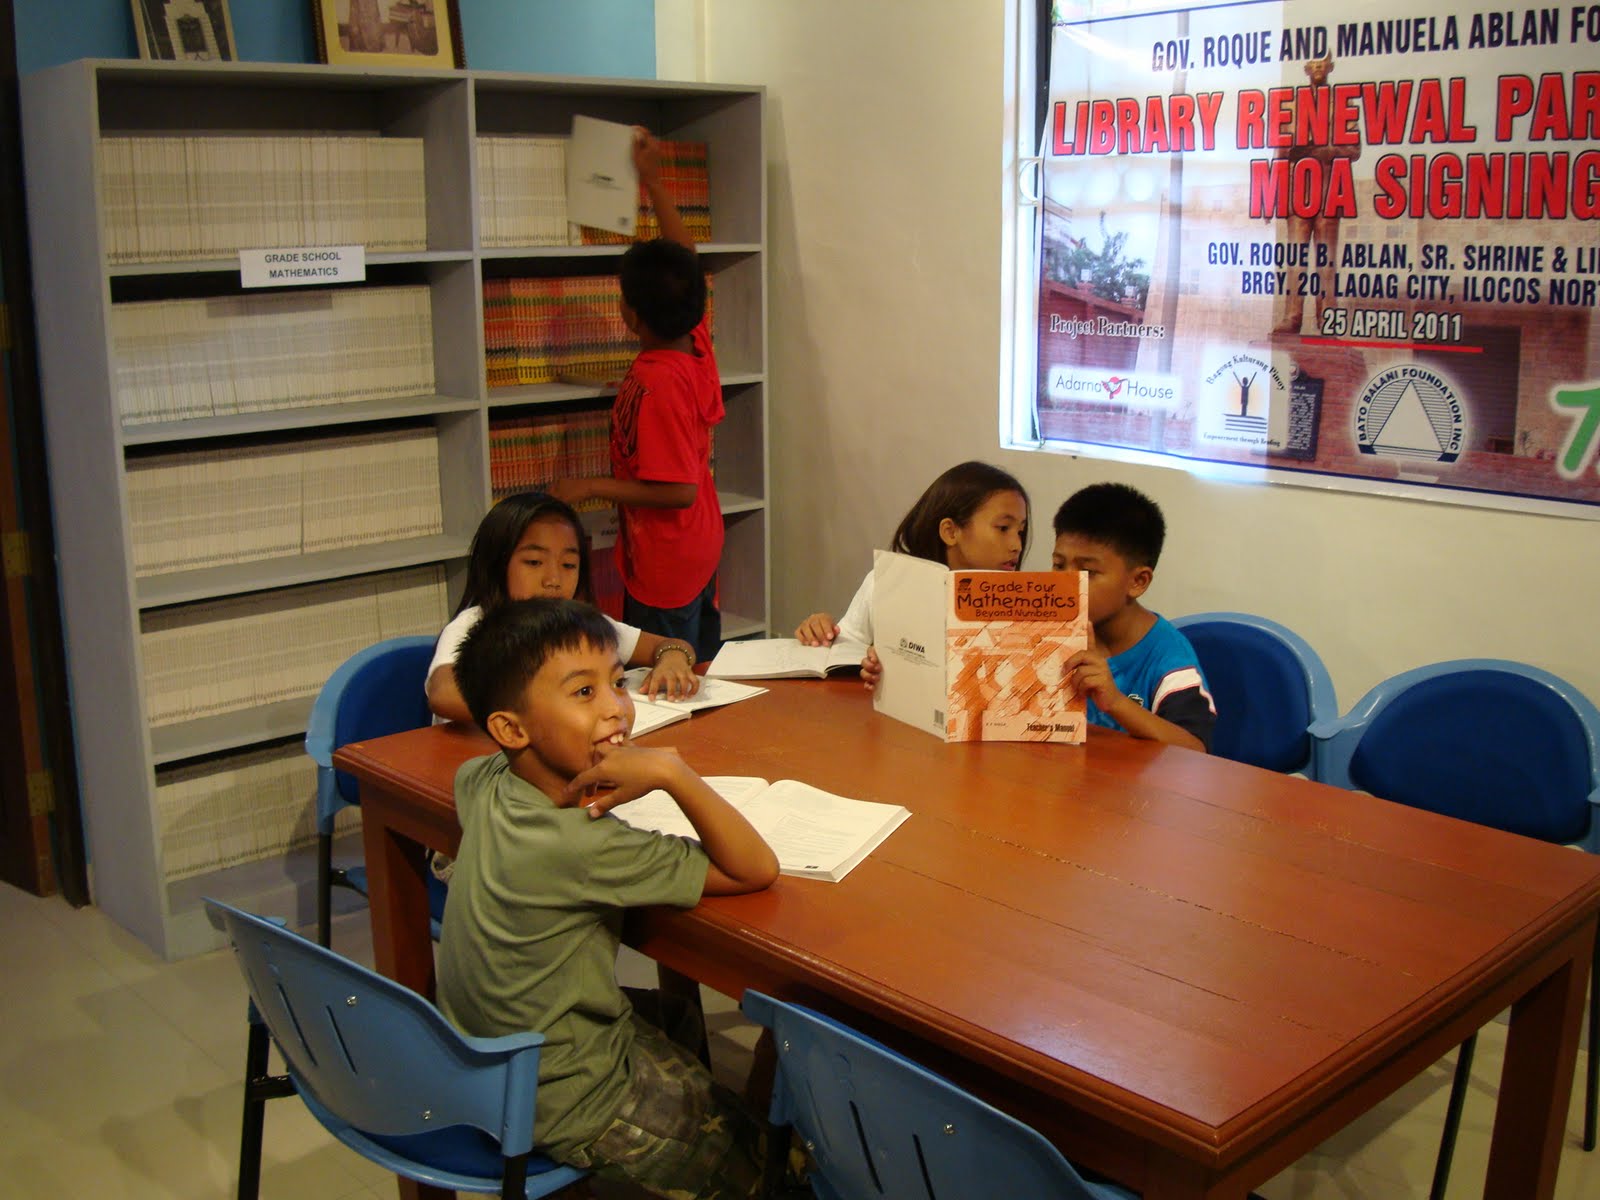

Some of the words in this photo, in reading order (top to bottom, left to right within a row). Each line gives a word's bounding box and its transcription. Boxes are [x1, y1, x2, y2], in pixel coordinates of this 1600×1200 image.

[1152, 39, 1194, 72] GOV.
[1203, 31, 1271, 69] ROQUE
[1279, 26, 1328, 61] AND
[1337, 15, 1459, 58] MANUELA
[1468, 8, 1559, 49] ABLAN
[1052, 91, 1224, 156] LIBRARY
[1236, 77, 1477, 149] RENEWAL
[1249, 154, 1358, 219] MOA
[1373, 150, 1600, 220] SIGNING
[264, 253, 299, 263] GRADE
[302, 251, 341, 262] SCHOOL
[1208, 241, 1243, 266] GOV.
[1250, 243, 1309, 269] ROQUE
[1316, 243, 1334, 267] B.
[1342, 244, 1413, 272] ABLAN,
[1421, 244, 1455, 270] SR.
[1463, 245, 1544, 272] SHRINE
[1552, 246, 1568, 273] &
[1576, 247, 1600, 274] LI
[269, 267, 338, 278] MATHEMATICS
[1241, 271, 1290, 296] BRGY.
[1298, 272, 1326, 299] 20,
[1334, 273, 1399, 299] LAOAG
[1407, 274, 1454, 304] CITY,
[1463, 276, 1541, 304] ILOCOS
[1549, 278, 1600, 307] NOR
[1050, 314, 1094, 339] Project
[1097, 316, 1165, 338] Partners:
[1322, 308, 1347, 336] 25
[1351, 309, 1408, 339] APRIL
[1412, 312, 1462, 341] 2011
[1206, 361, 1232, 385] Bagong
[1232, 354, 1269, 372] Kulturang
[1269, 366, 1286, 391] Pinoy
[1055, 375, 1102, 393] Adarna
[1127, 380, 1173, 399] House
[1357, 406, 1367, 441] BATO
[1363, 370, 1399, 405] BALANI
[1402, 368, 1462, 423] FOUNDATION
[1450, 427, 1462, 451] INC
[1203, 432, 1238, 442] Empowerment
[1239, 435, 1260, 445] through
[1260, 437, 1281, 447] Reading
[979, 581, 1023, 593] Grade
[1026, 581, 1056, 592] Four
[957, 593, 1075, 609] Mathematics
[975, 609, 1013, 618] Beyond
[1015, 608, 1058, 617] Numbers
[908, 641, 925, 654] DIWA
[1026, 722, 1053, 733] Teacher's
[1054, 723, 1075, 733] Manual
